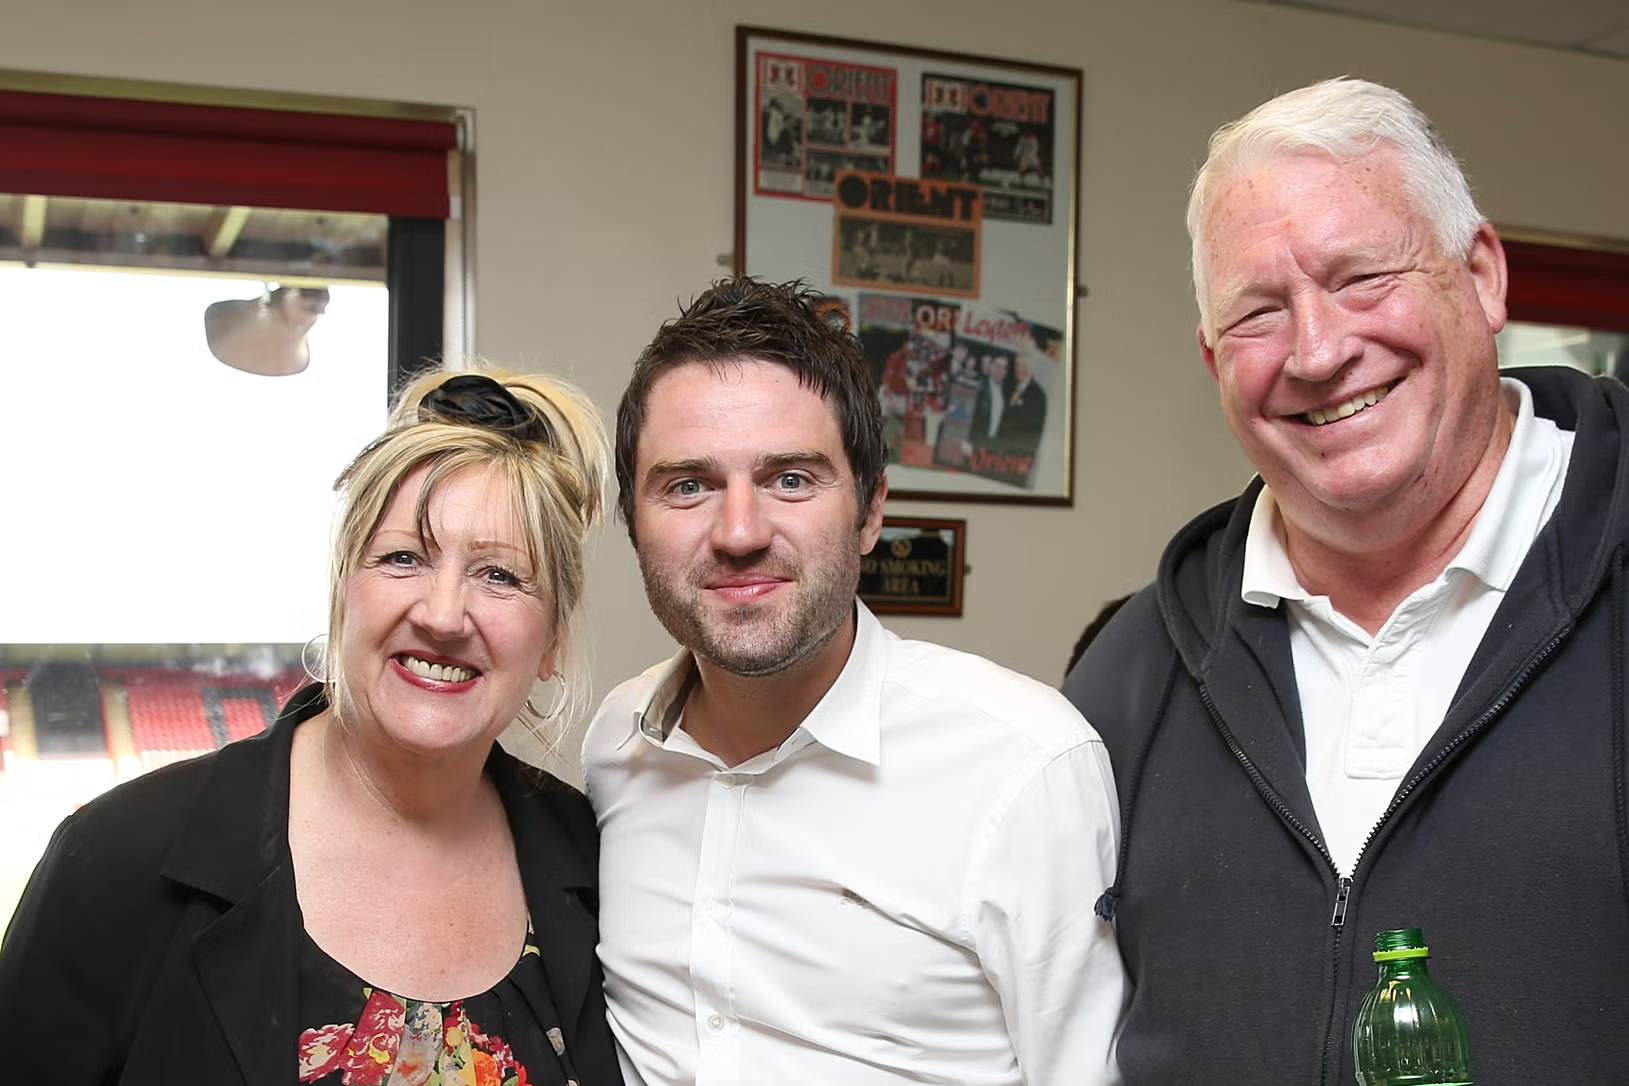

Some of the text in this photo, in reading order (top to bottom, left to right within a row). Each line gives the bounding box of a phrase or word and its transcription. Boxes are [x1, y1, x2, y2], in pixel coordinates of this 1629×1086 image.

[805, 62, 893, 101] ORIENT
[838, 174, 978, 220] ORIENT
[880, 559, 946, 576] SMOKING
